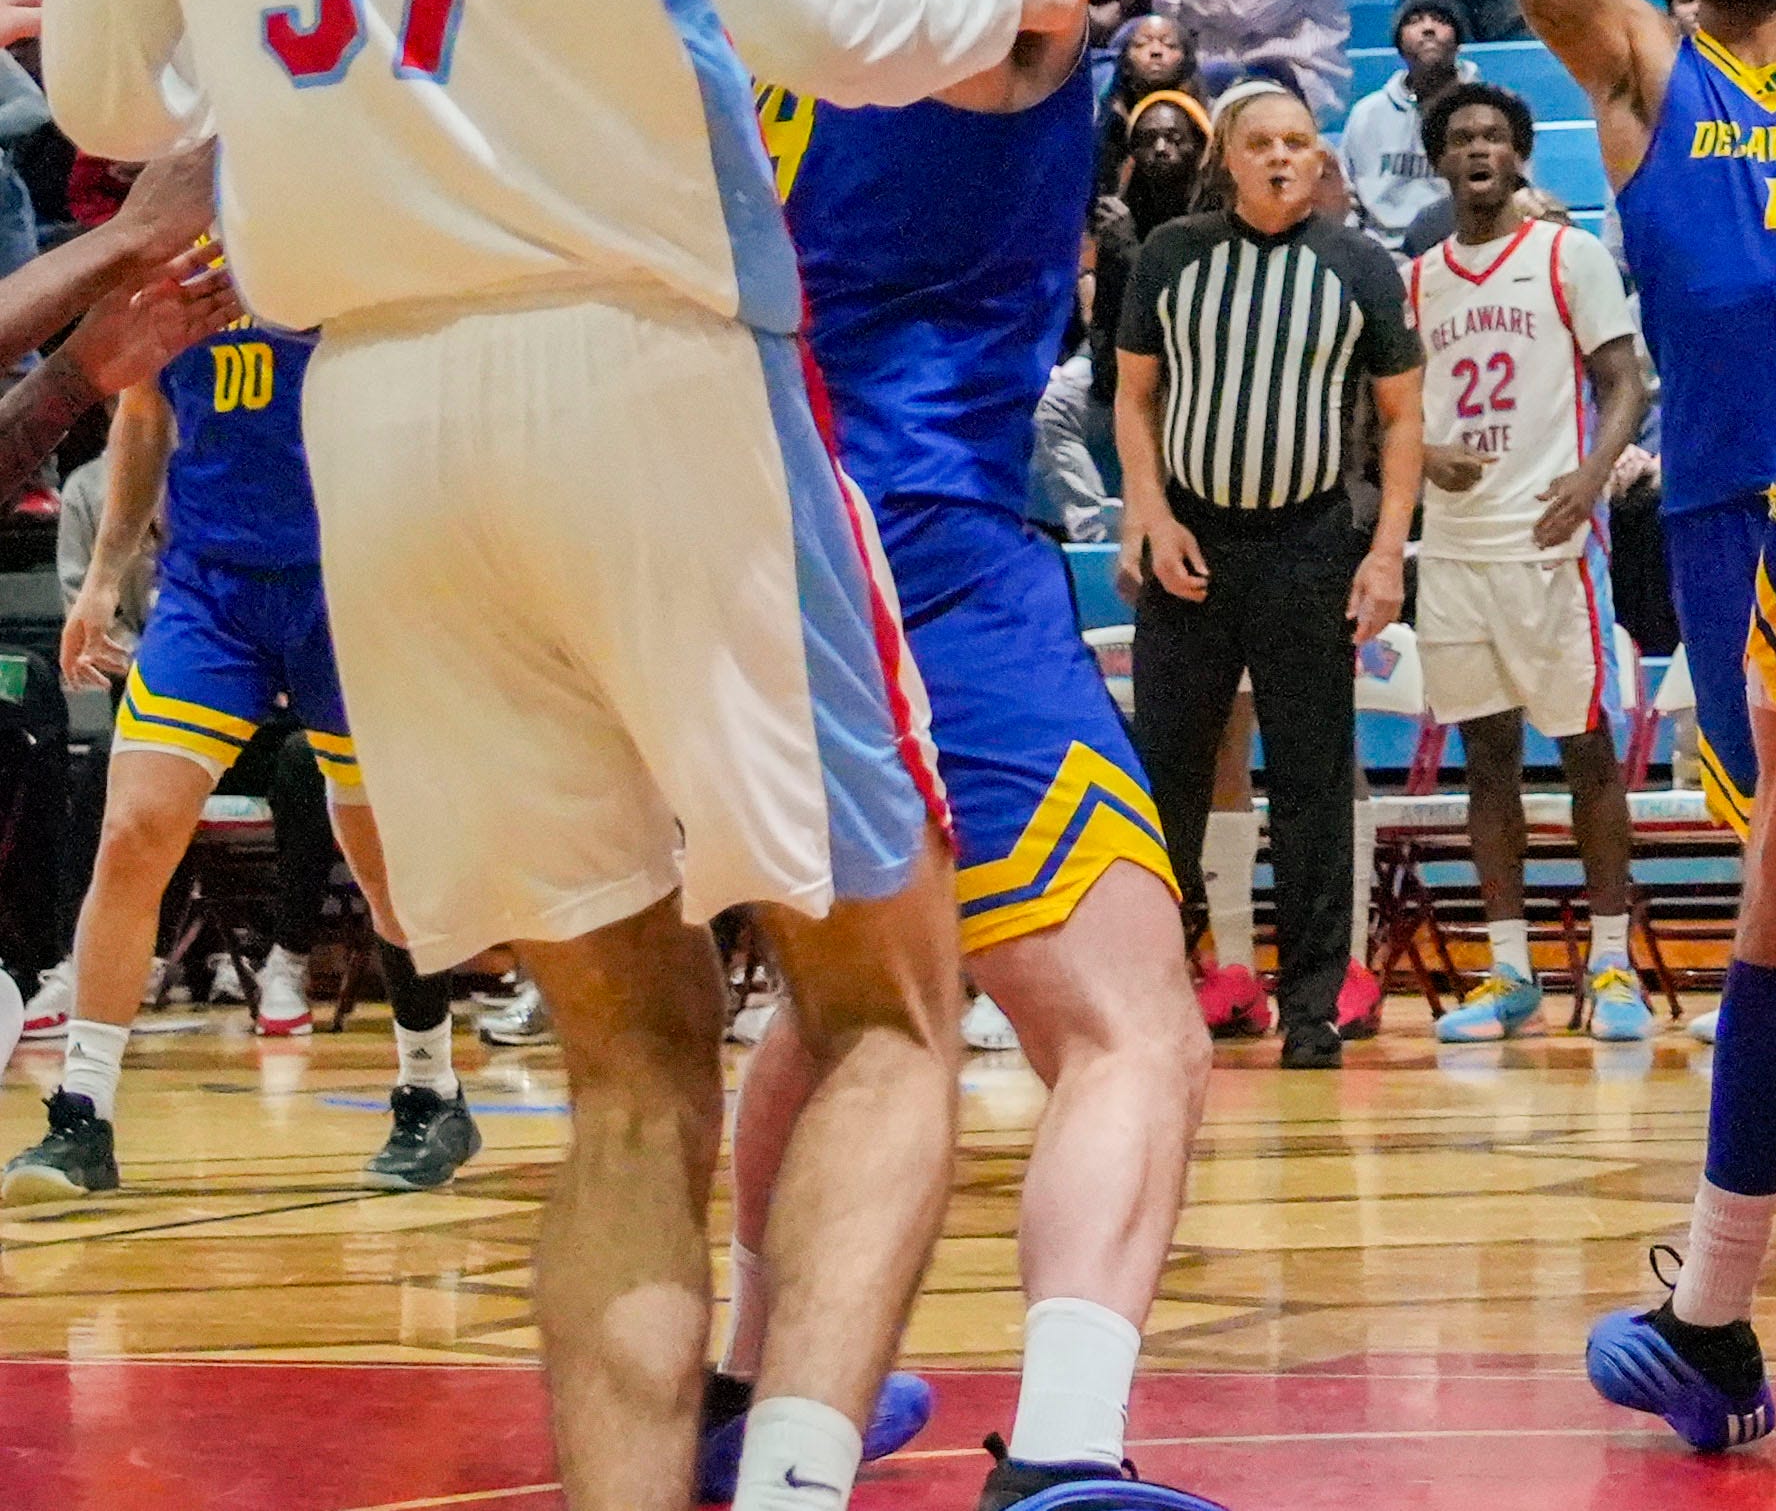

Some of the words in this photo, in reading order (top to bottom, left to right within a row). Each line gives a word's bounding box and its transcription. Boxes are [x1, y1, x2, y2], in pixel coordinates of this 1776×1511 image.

[1430, 304, 1537, 352] DELAWARE
[211, 343, 274, 414] 00
[1451, 351, 1517, 418] 22
